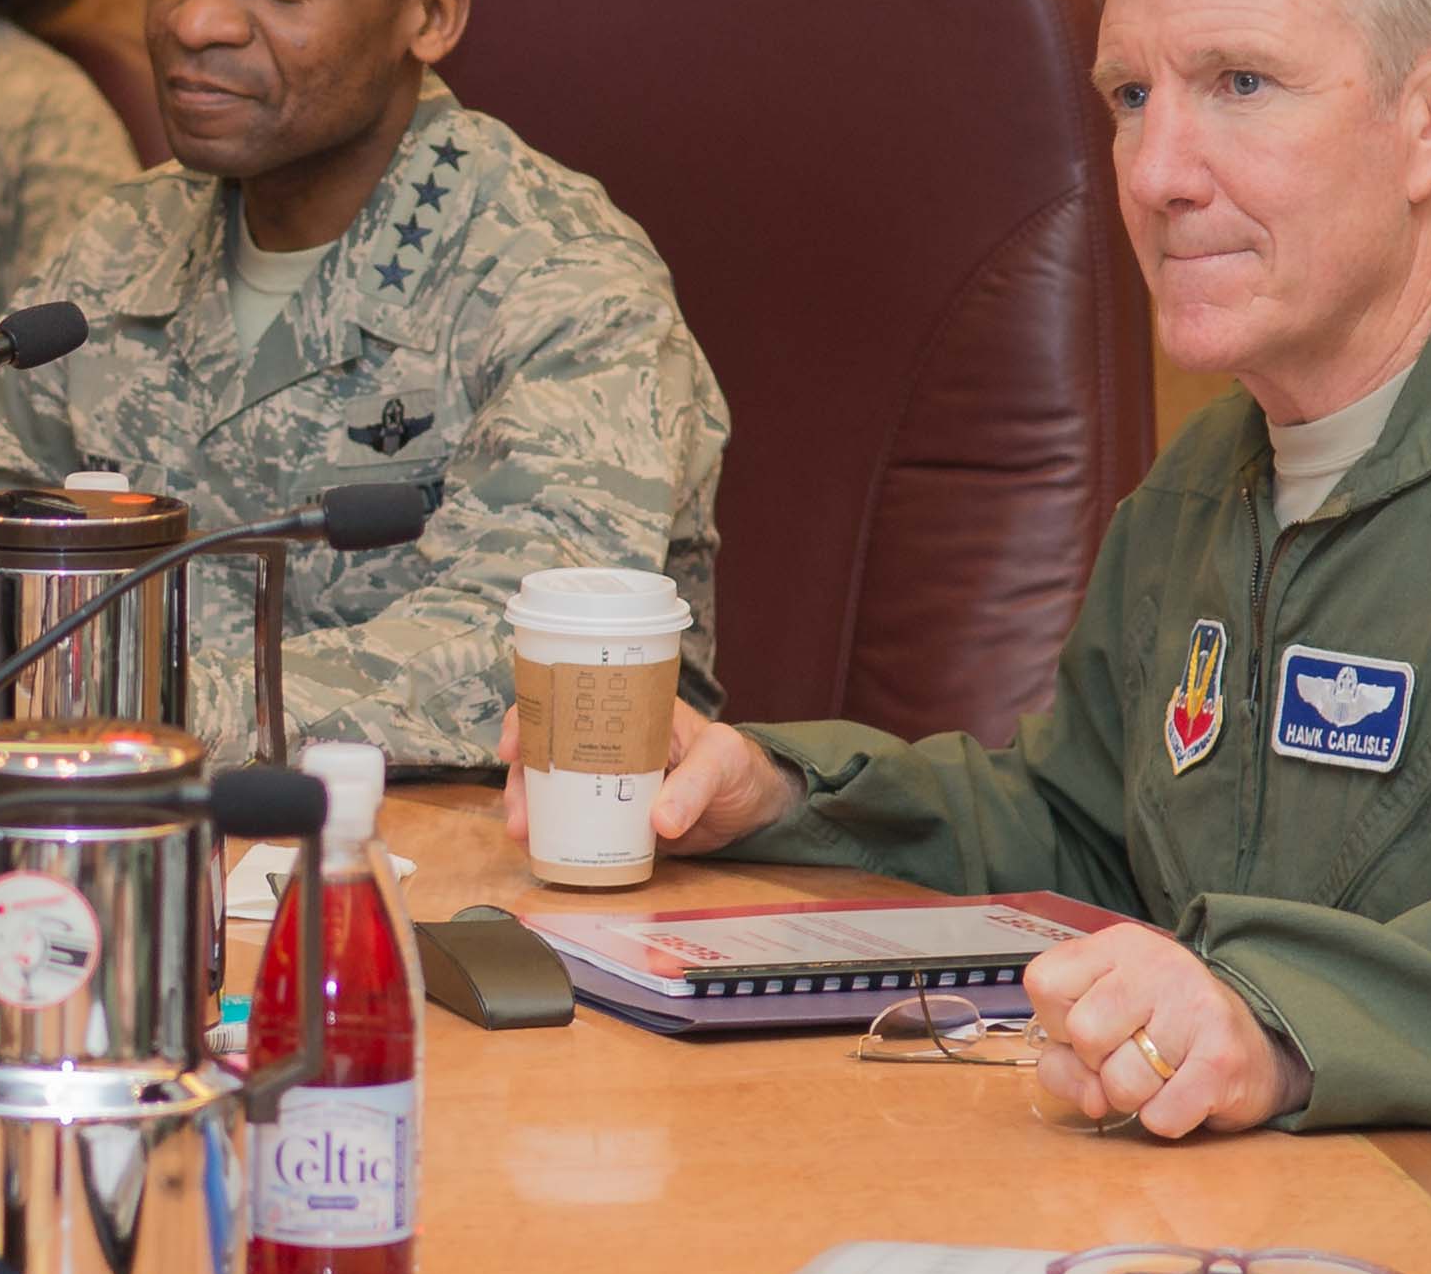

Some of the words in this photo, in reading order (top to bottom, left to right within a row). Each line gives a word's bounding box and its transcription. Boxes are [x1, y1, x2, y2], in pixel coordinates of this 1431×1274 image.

[1285, 723, 1323, 748] HAWK
[1328, 730, 1391, 757] CARLISLE
[275, 1131, 391, 1184] Celtic
